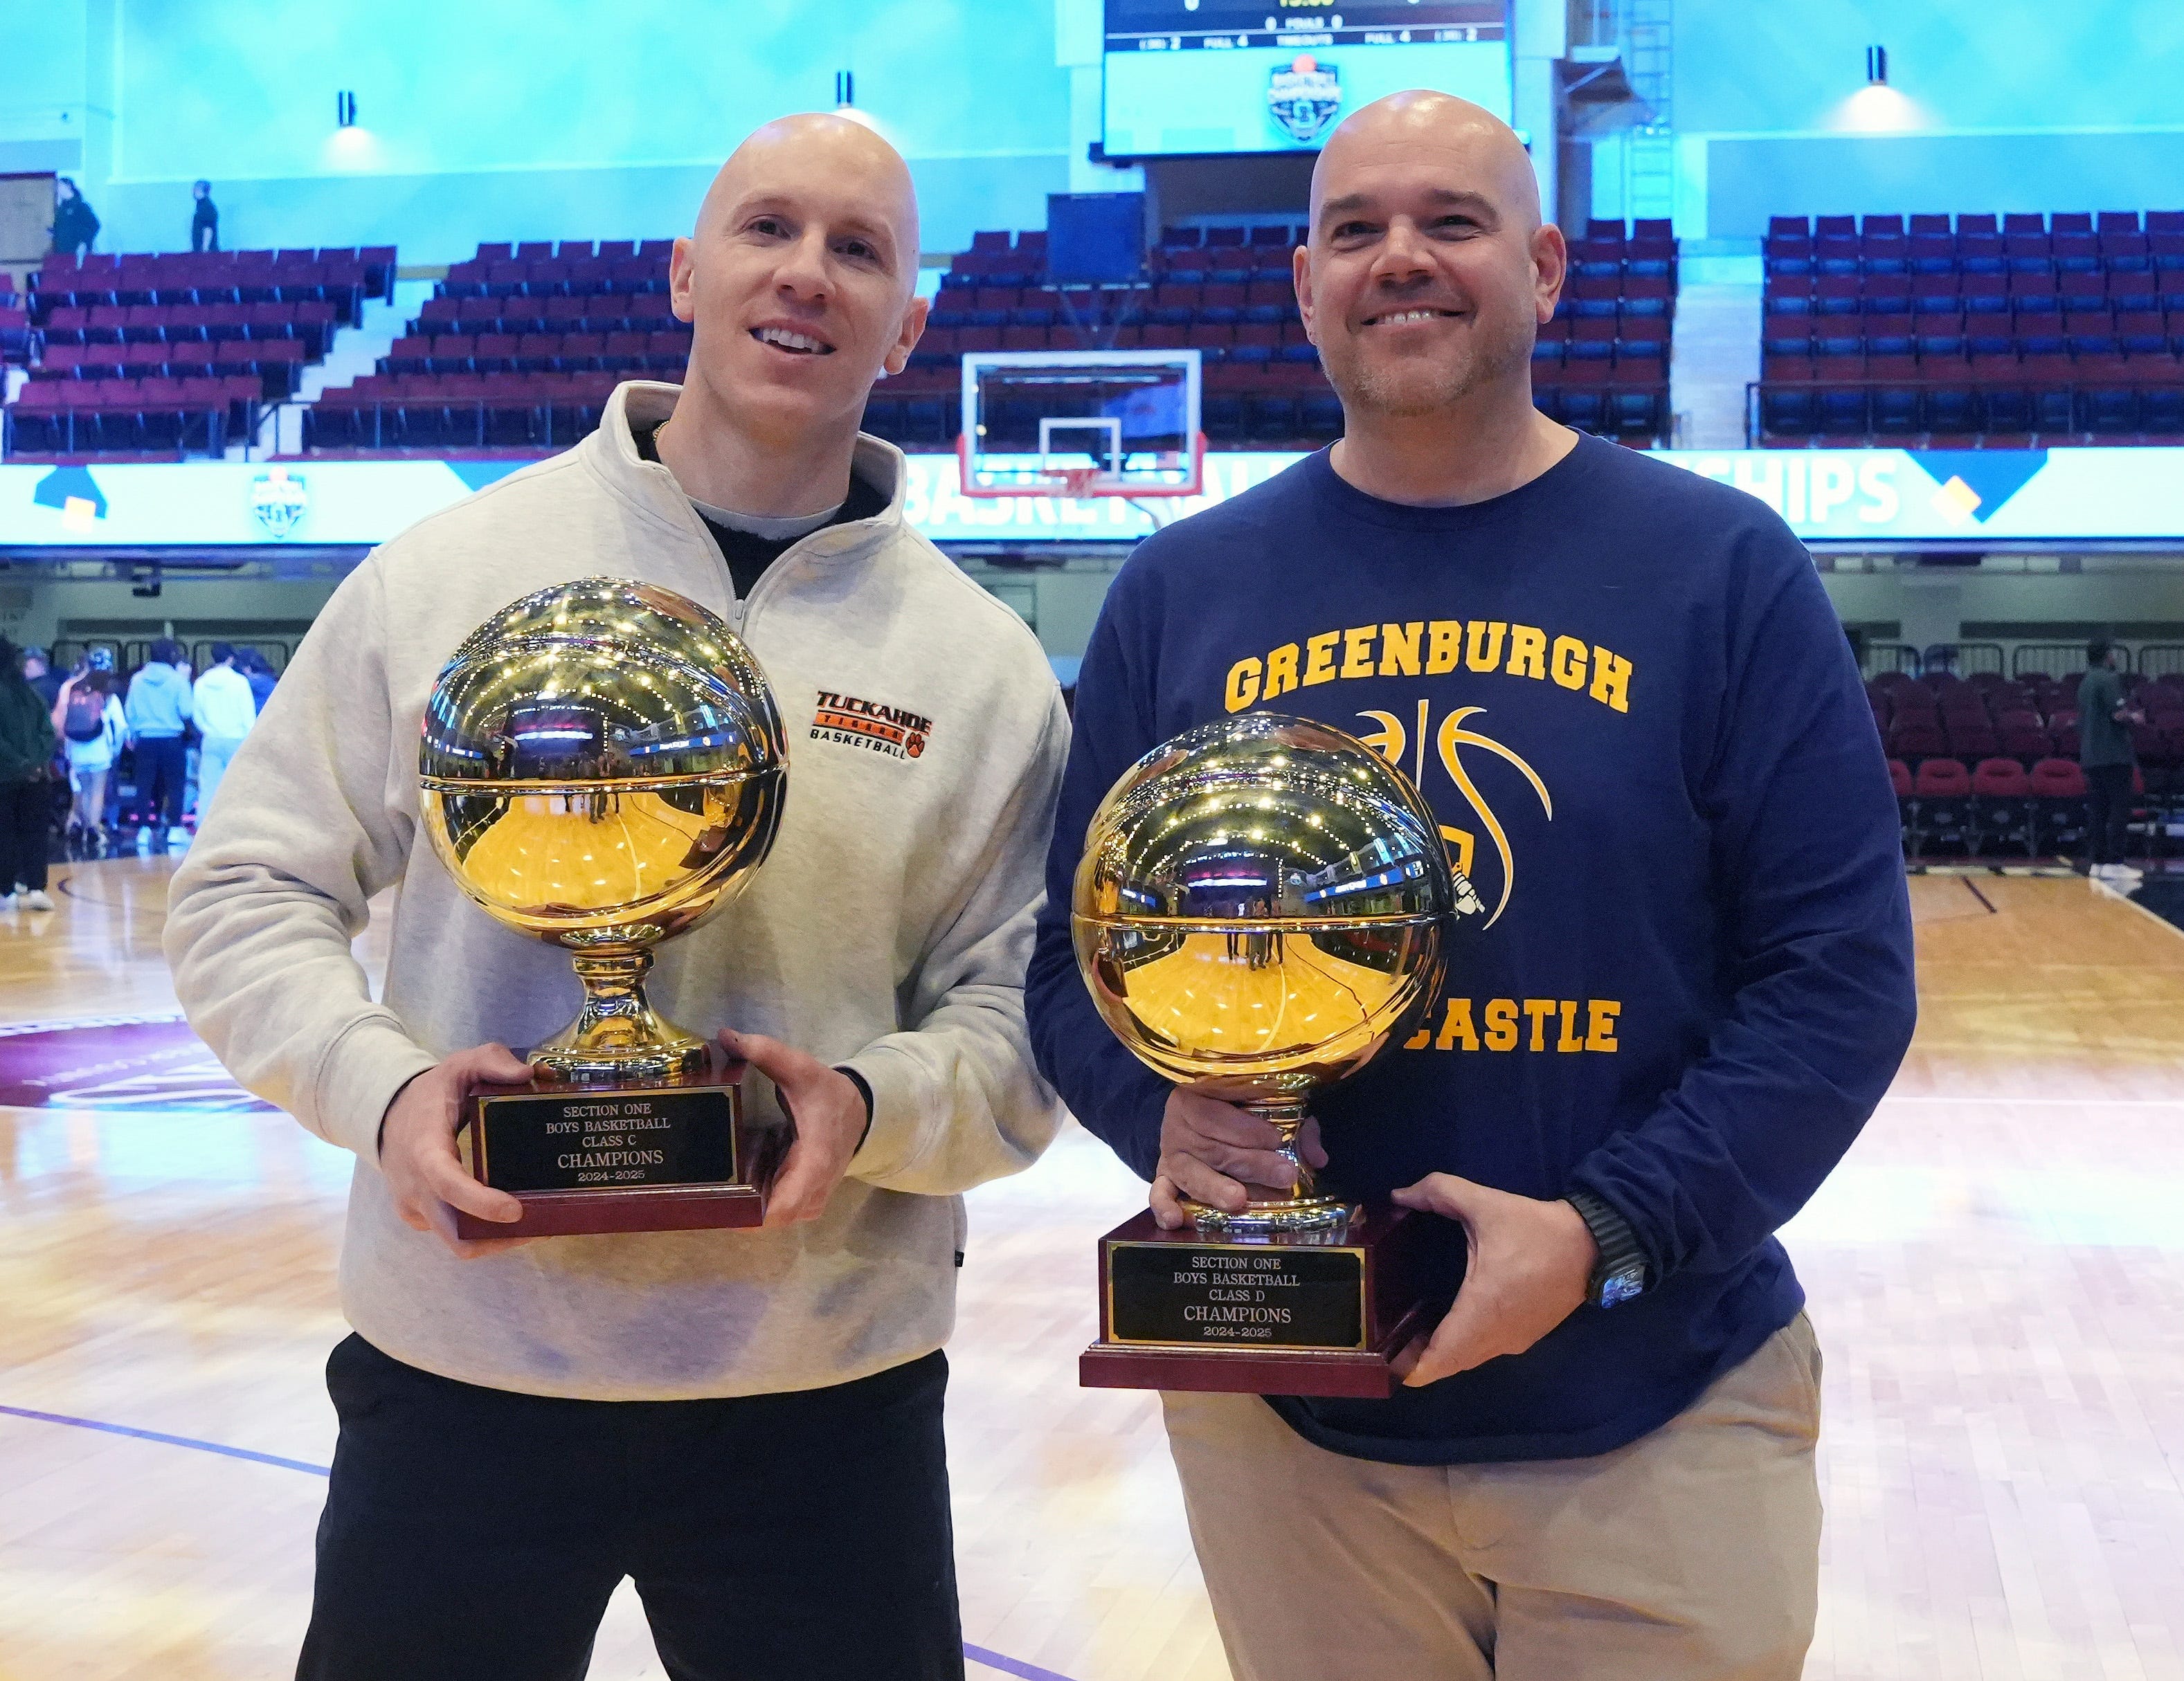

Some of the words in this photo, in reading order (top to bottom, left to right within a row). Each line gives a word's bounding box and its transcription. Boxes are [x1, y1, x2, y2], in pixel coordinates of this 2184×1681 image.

[1225, 620, 1633, 714] GREENBURGH
[817, 691, 932, 736] TUCKAHOE
[810, 729, 905, 760] BASKETBALL
[563, 1105, 619, 1118] SECTION
[624, 1103, 652, 1115] ONE
[545, 1122, 579, 1134] BOYS
[585, 1118, 671, 1132] BASKETBALL
[582, 1136, 623, 1147] CLASS
[628, 1134, 637, 1145] C
[557, 1150, 664, 1169] CHAMPIONS
[578, 1170, 645, 1182] 2024-2025
[1192, 1257, 1247, 1269] SECTION
[1254, 1258, 1281, 1270] ONE
[1174, 1272, 1207, 1284] BOYS
[1213, 1274, 1301, 1287] BASKETBALL
[1209, 1289, 1250, 1301] CLASS
[1255, 1291, 1265, 1302] D
[1184, 1306, 1292, 1323] CHAMPIONS
[1203, 1327, 1272, 1337] 2024-2025
